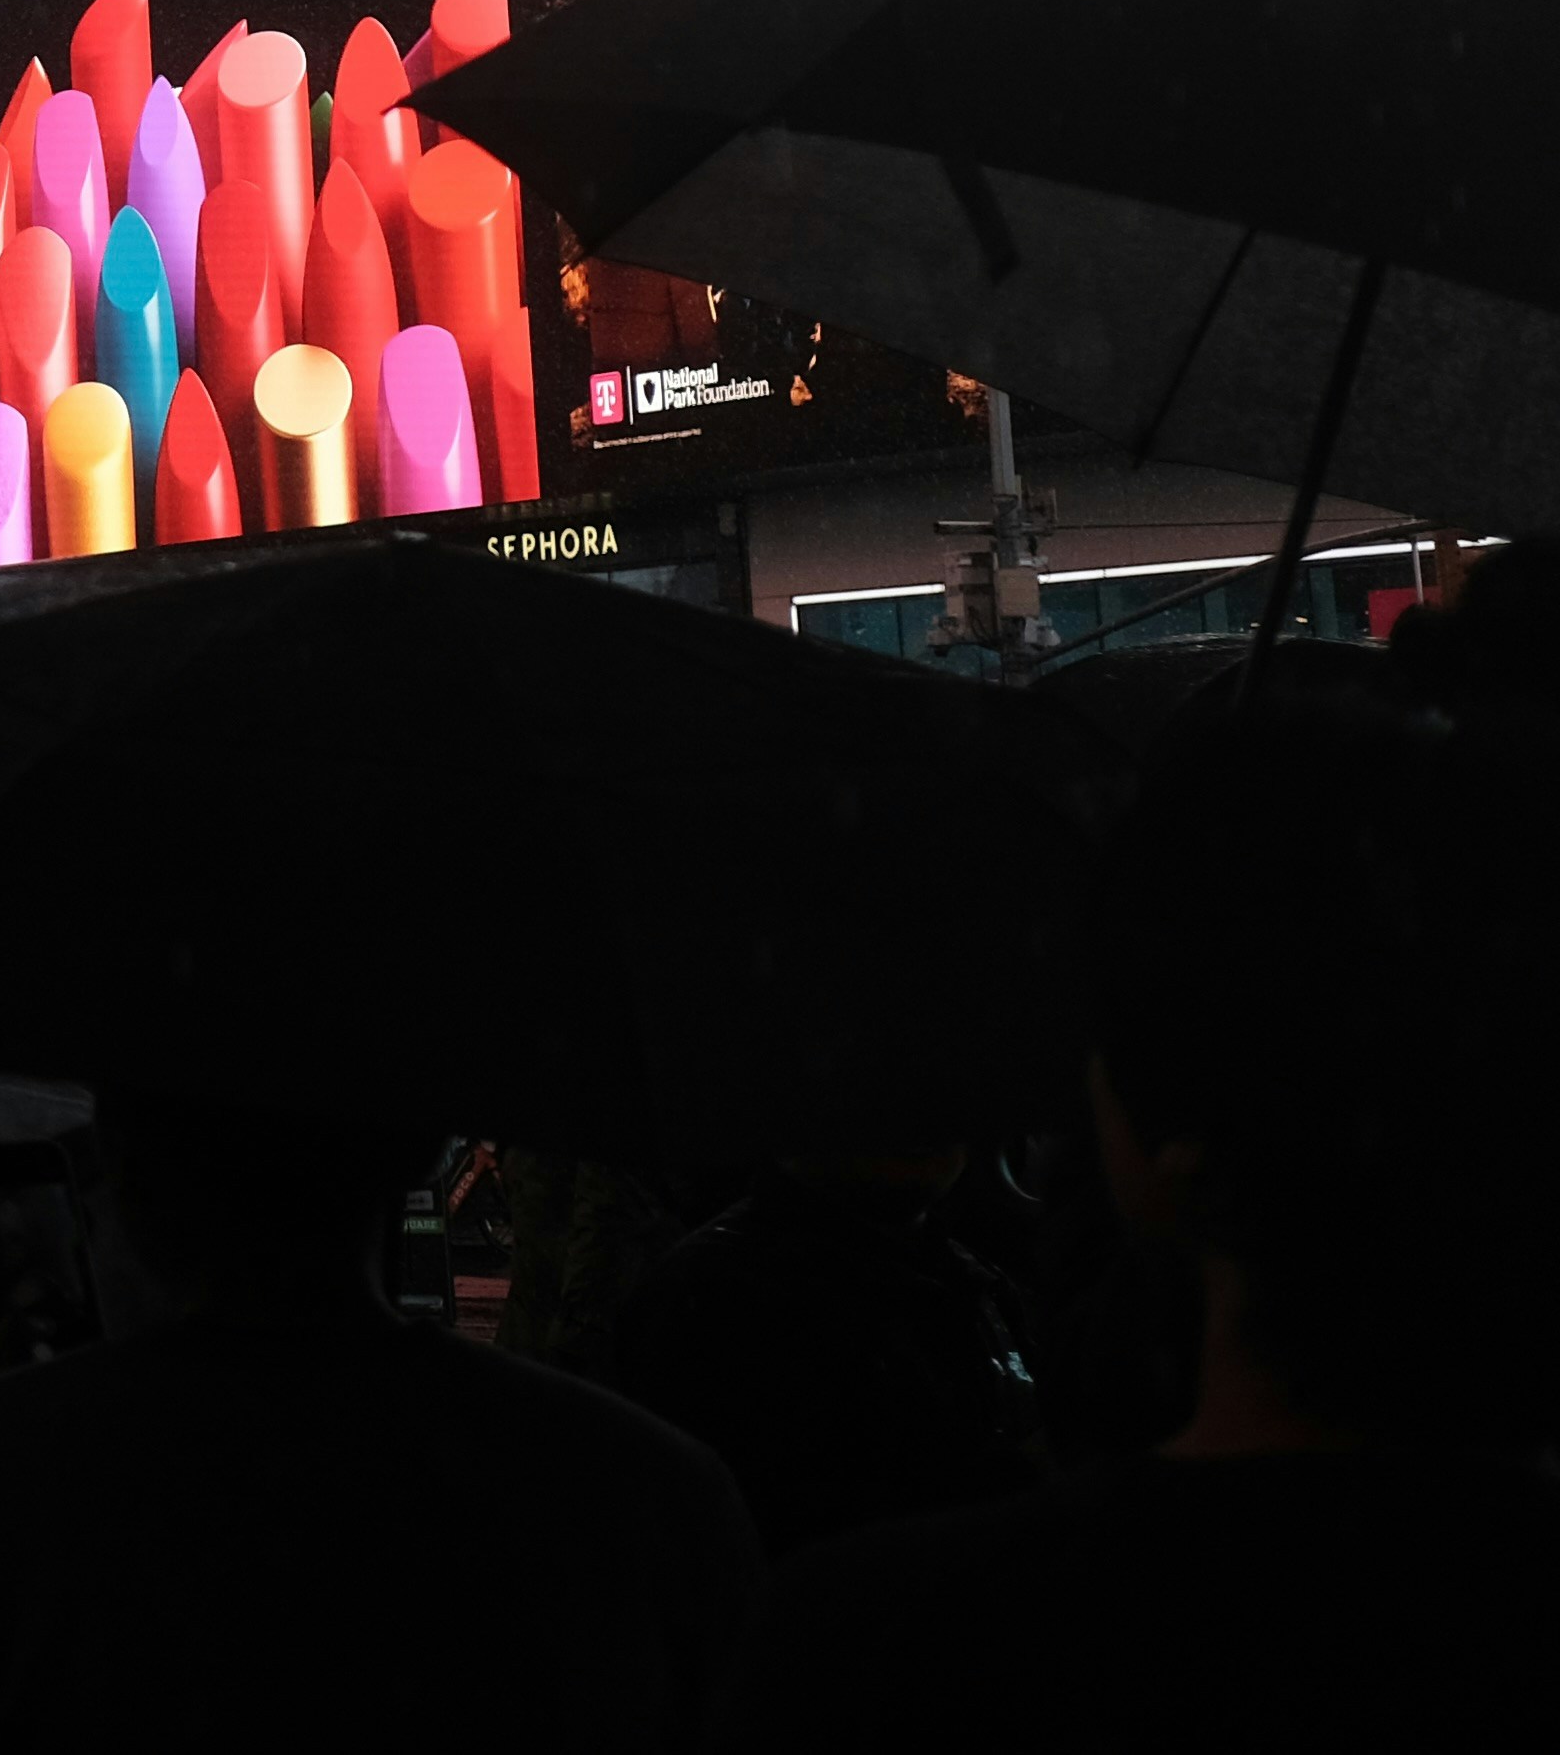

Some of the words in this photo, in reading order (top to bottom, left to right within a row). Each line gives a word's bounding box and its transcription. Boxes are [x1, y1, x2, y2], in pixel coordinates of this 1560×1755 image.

[663, 362, 719, 386] National
[663, 387, 697, 411] Park
[487, 522, 619, 561] SEPHORA
